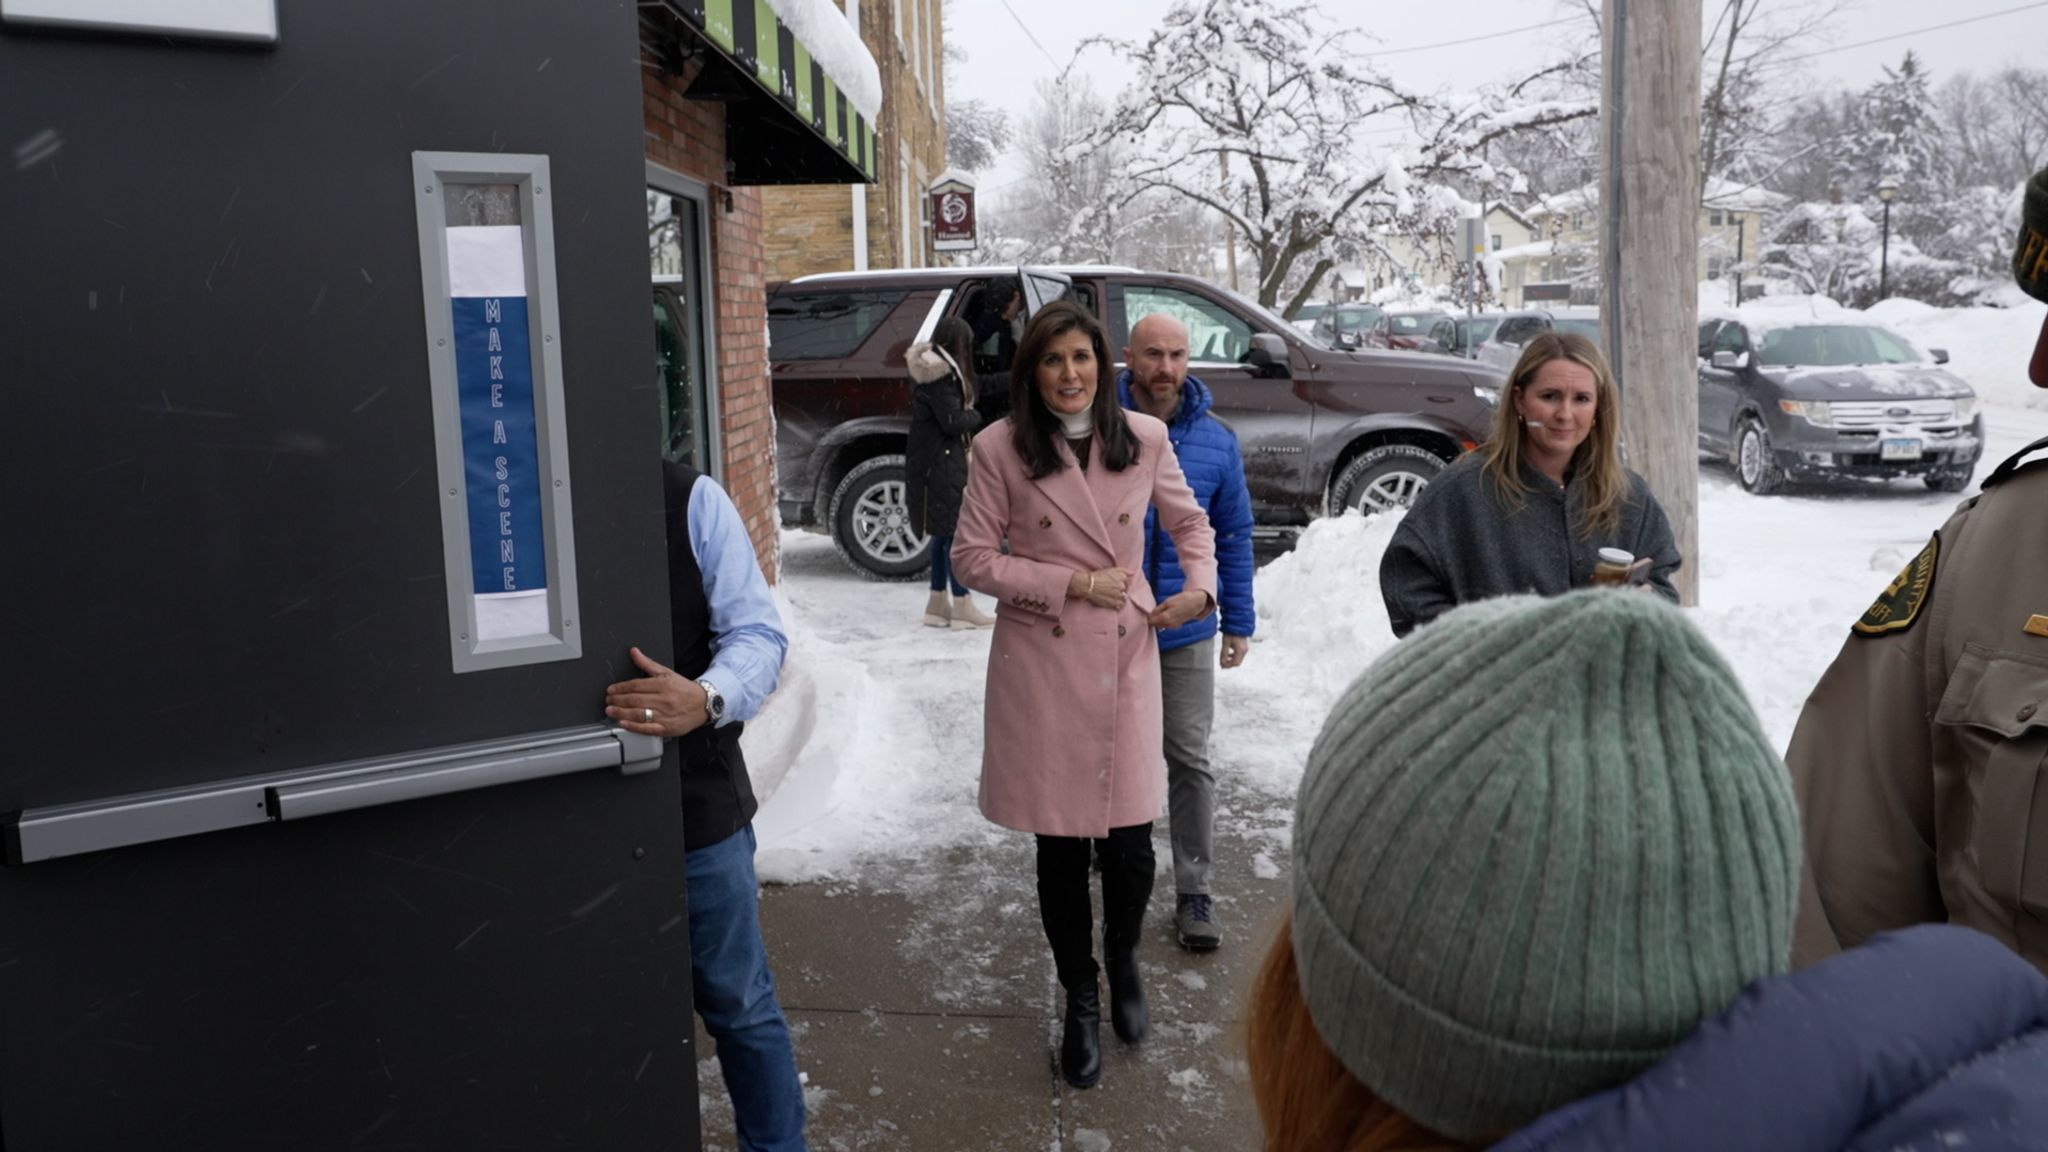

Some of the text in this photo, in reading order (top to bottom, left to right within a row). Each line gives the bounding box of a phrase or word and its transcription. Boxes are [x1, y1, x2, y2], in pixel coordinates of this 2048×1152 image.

[485, 299, 516, 590] MAKE A SCENE
